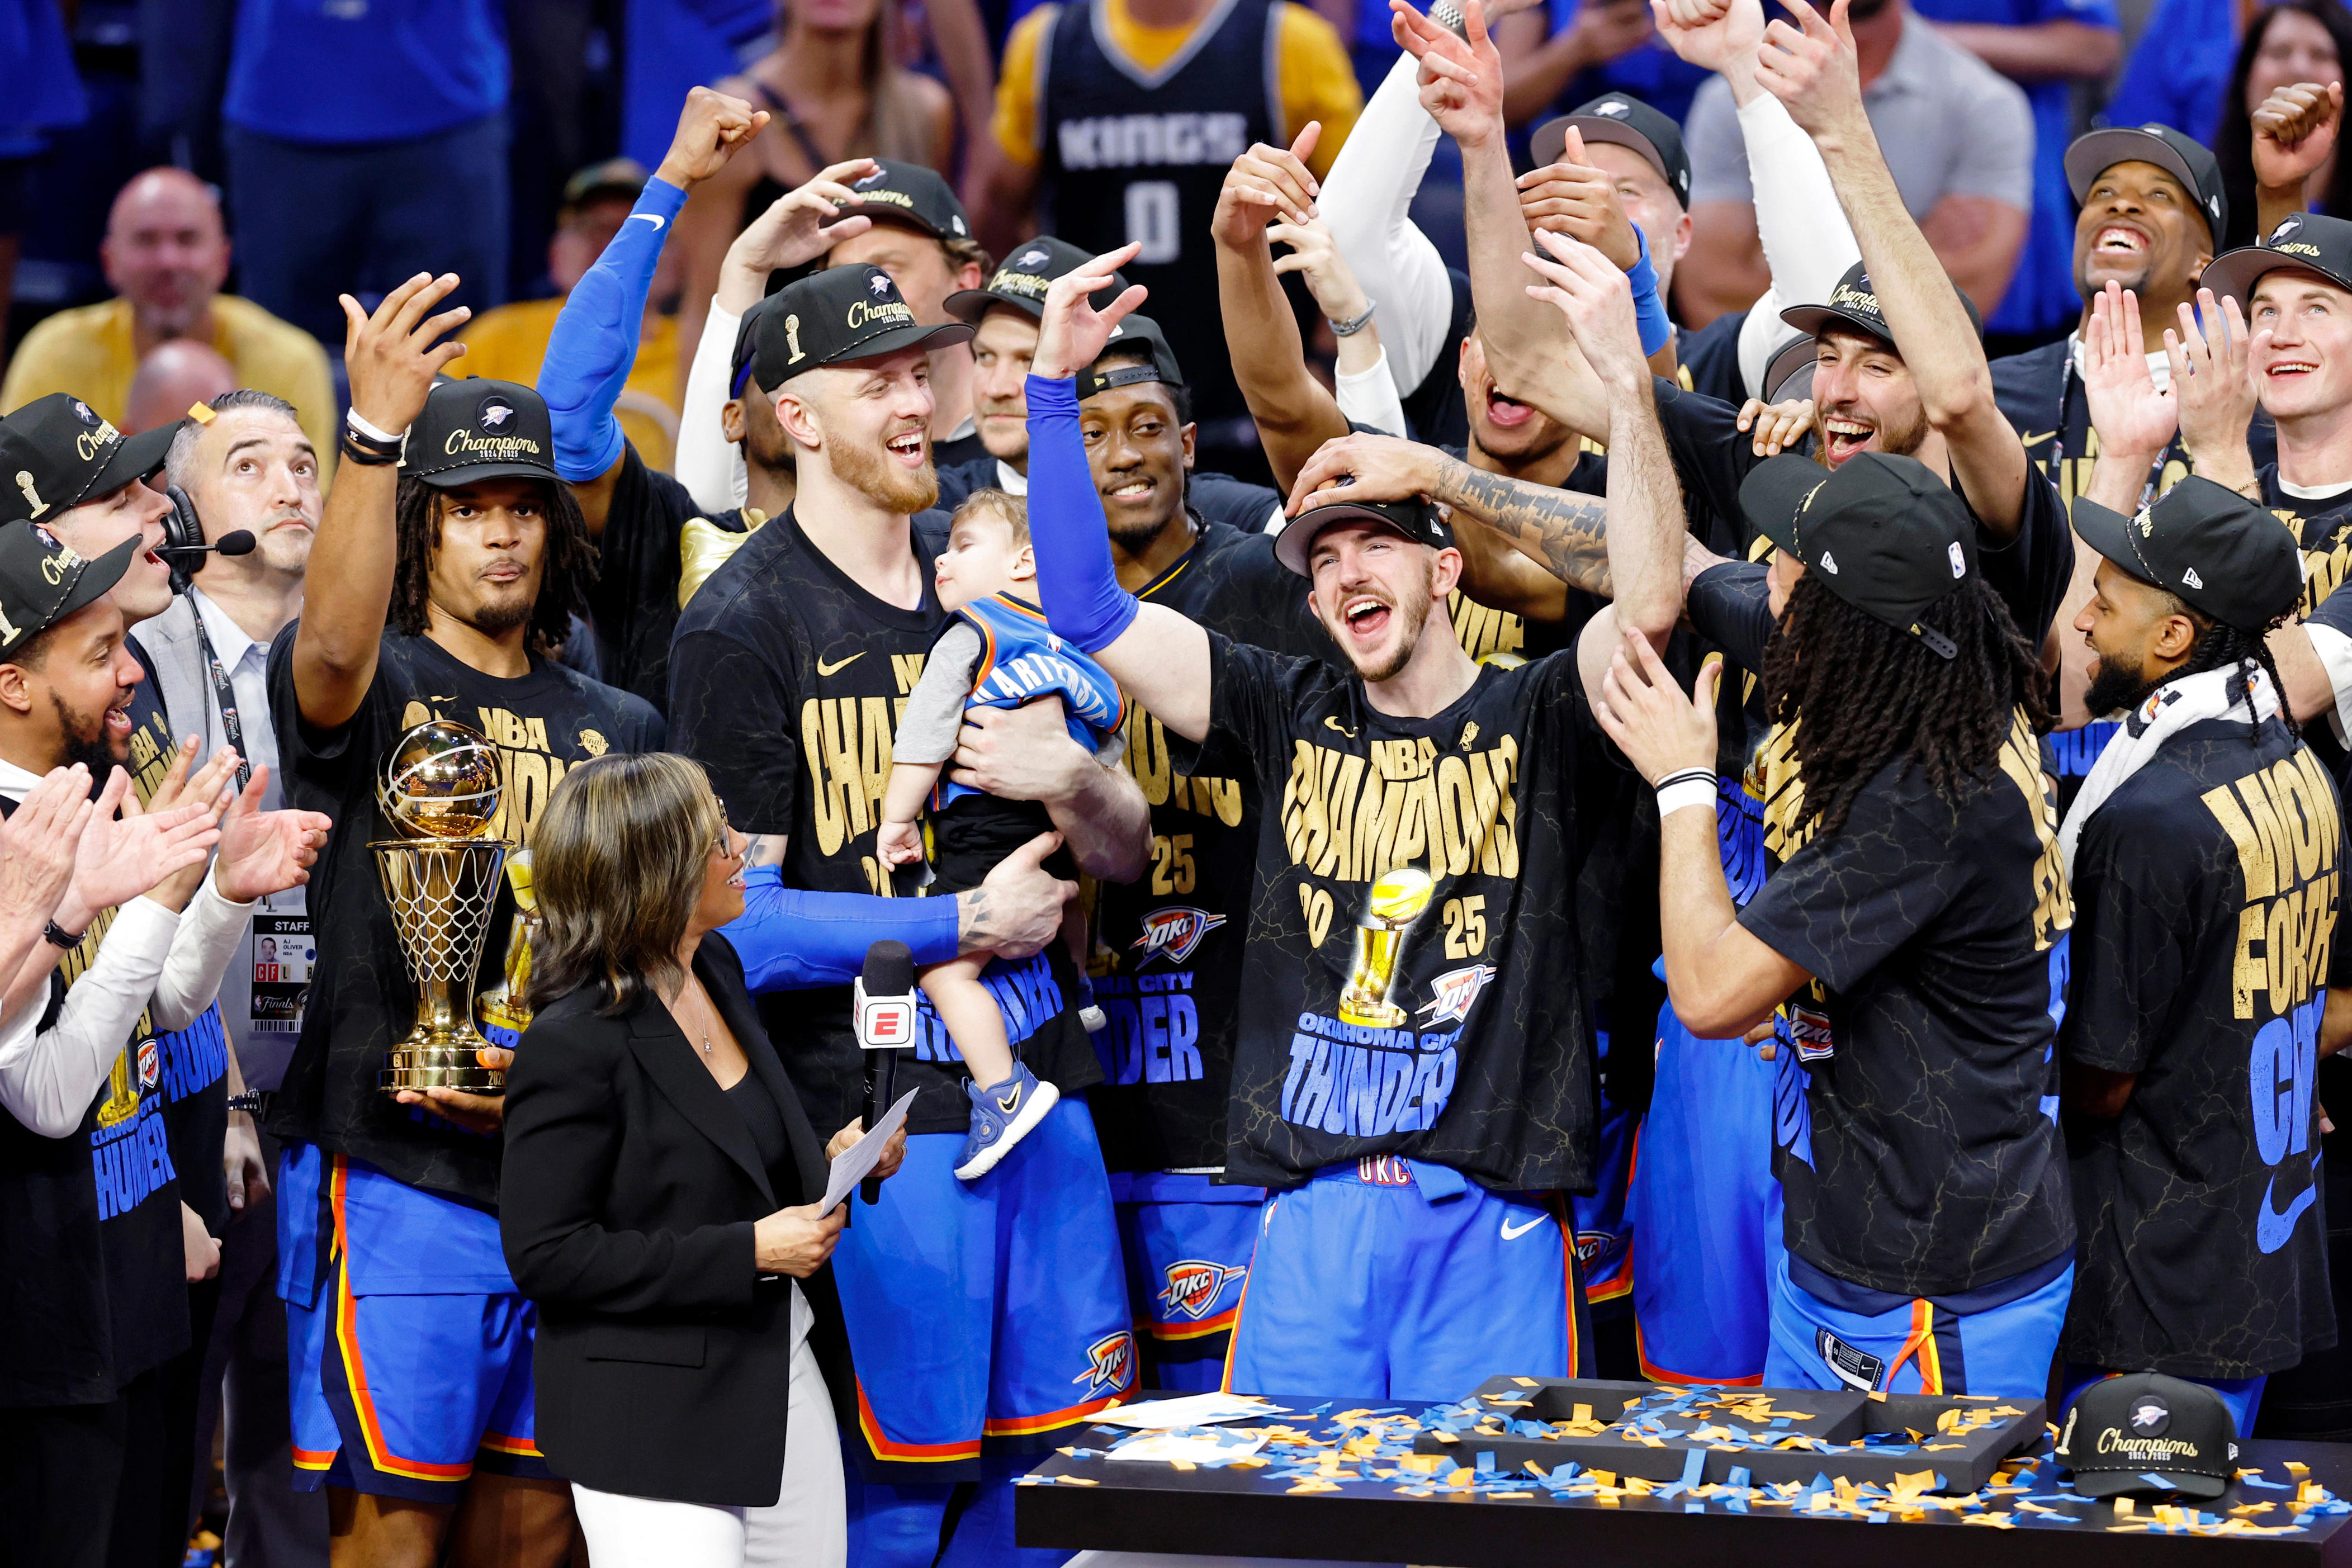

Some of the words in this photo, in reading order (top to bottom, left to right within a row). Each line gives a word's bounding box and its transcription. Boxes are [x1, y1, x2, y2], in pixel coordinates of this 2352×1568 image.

[1058, 113, 1247, 168] KINGS
[1125, 181, 1180, 264] 0
[349, 430, 358, 441] TC
[444, 429, 540, 455] Champions
[480, 449, 497, 458] 2024
[477, 706, 552, 754] NBA
[1371, 736, 1438, 780] NBA
[1280, 733, 1520, 883] CHAMPIONS
[1151, 833, 1196, 896] 25
[275, 921, 309, 931] STAFF
[1148, 916, 1194, 948] OKC
[1442, 894, 1487, 960] 25
[258, 966, 264, 979] C
[271, 966, 276, 979] F
[283, 967, 287, 979] L
[1138, 971, 1194, 992] CITY
[260, 996, 294, 1013] Finals
[874, 1012, 899, 1035] E
[1298, 1012, 1415, 1049] OKLAHOMA
[1420, 1024, 1465, 1051] CITY
[488, 1070, 504, 1086] 202
[1281, 1033, 1458, 1137] THUNDER
[1169, 1271, 1210, 1306] OKC
[1095, 1343, 1127, 1385] OKC
[2097, 1427, 2199, 1457] Champions
[2128, 1451, 2147, 1460] 2024
[2152, 1452, 2171, 1461] 2025
